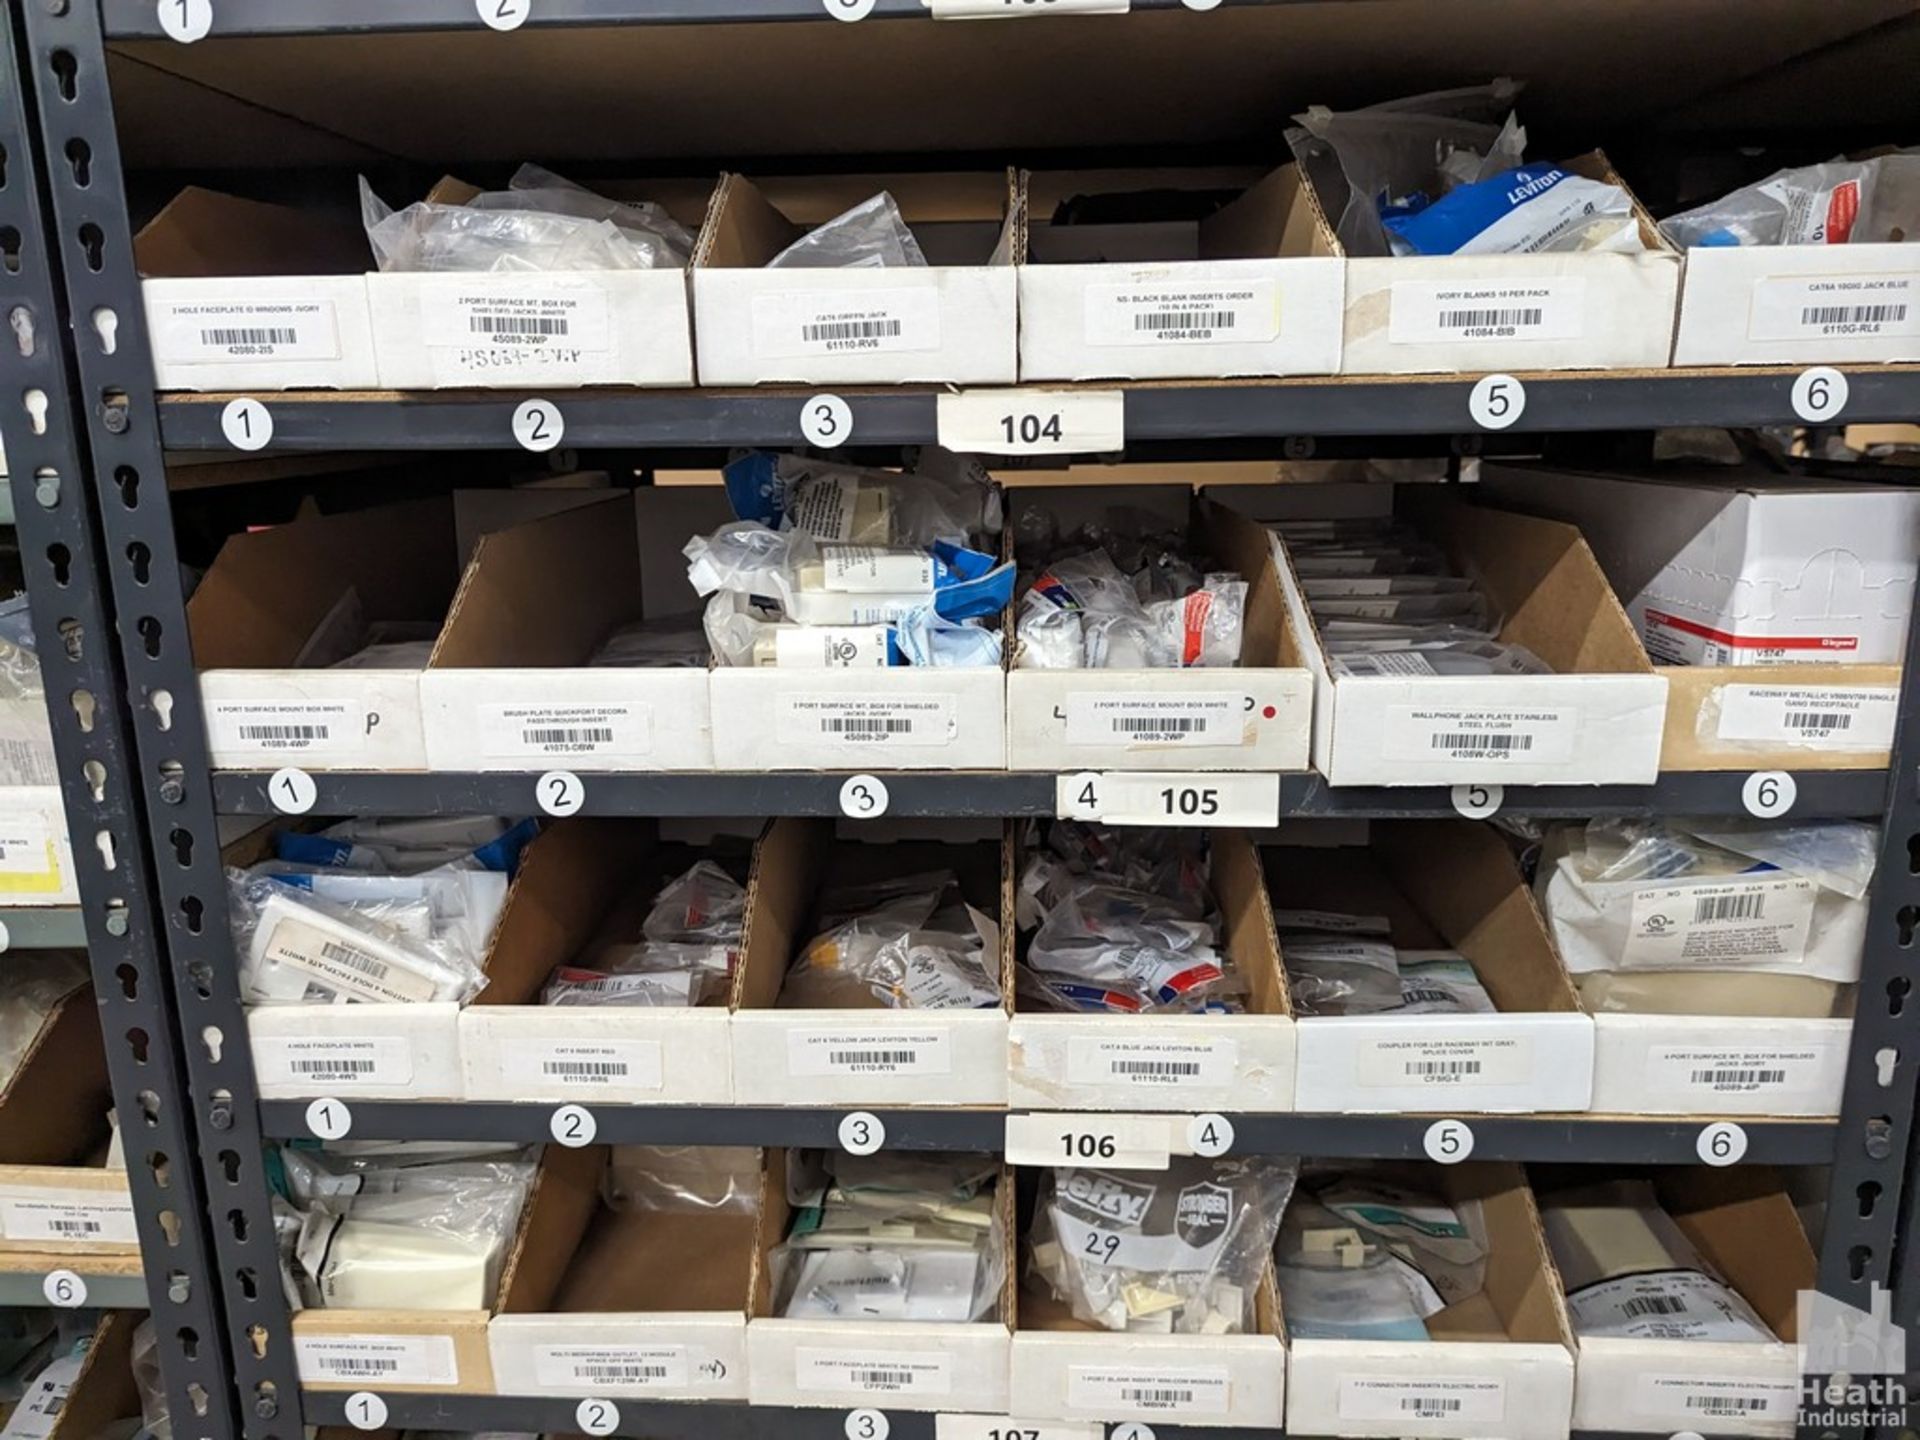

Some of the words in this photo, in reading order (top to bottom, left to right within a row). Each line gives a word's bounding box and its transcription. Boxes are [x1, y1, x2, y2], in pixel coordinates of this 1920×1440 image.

[1436, 292, 1462, 300] IVORY
[1463, 291, 1496, 299] BLANKS
[1509, 290, 1525, 298] PER
[1527, 289, 1551, 297] PACK
[1864, 282, 1885, 290] JACK
[1887, 281, 1909, 289] BLUE
[178, 305, 199, 314] HOLE
[201, 304, 245, 314] FACEPLATE
[256, 303, 293, 313] WINDOWS
[488, 298, 524, 307] SURFACE
[560, 300, 577, 308] FOR
[1132, 295, 1159, 303] BLACK
[1161, 294, 1188, 302] BLANK
[1190, 293, 1224, 301] INSERTS
[1226, 292, 1254, 300] ORDER
[867, 311, 888, 319] JACK
[492, 334, 548, 344] 45089-2WP
[826, 339, 879, 351] 61110-RV6
[1488, 384, 1509, 418] 5
[1807, 377, 1829, 410] 6
[237, 408, 251, 439] 1
[526, 409, 549, 440] 2
[815, 405, 836, 436] 3
[999, 414, 1063, 444] 104
[798, 702, 819, 710] PORT
[820, 702, 854, 710] SURFACE
[886, 703, 902, 711] FOR
[903, 703, 940, 711] SHIELDED
[1099, 702, 1120, 710] PORT
[1121, 702, 1156, 710] SURFACE
[1158, 702, 1185, 710] MOUNT
[1186, 702, 1203, 710] BOX
[1205, 702, 1228, 710] WHITE
[1749, 690, 1788, 698] RACEWAY
[1789, 691, 1828, 700] METALLIC
[1868, 694, 1896, 702] SINGLE
[1785, 700, 1808, 708] GANG
[1809, 701, 1860, 709] RECEPTACLE
[503, 710, 528, 718] BRUSH
[530, 709, 553, 717] PLATE
[554, 708, 596, 716] QUICKPORT
[597, 708, 628, 716] DECORA
[1411, 712, 1462, 720] WALLPHONE
[1463, 712, 1484, 720] JACK
[1486, 712, 1512, 721] PLATE
[1514, 713, 1559, 721] STAINLESS
[1458, 721, 1482, 729] STEEL
[1484, 721, 1512, 729] FLUSH
[1801, 728, 1830, 738] V5747
[1133, 732, 1185, 742] 41089-2WP
[281, 777, 298, 804] 1
[549, 780, 570, 808] 2
[851, 784, 875, 811] 3
[1078, 781, 1098, 810] 4
[1758, 778, 1779, 808] 6
[1160, 788, 1219, 816] 105
[1637, 891, 1655, 900] CAT
[1666, 890, 1681, 898] NO
[1773, 883, 1787, 891] NO
[858, 1036, 876, 1044] JACK
[908, 1035, 938, 1043] YELLOW
[1413, 1041, 1428, 1049] FOR
[1444, 1041, 1480, 1049] RACEWAY
[1422, 1048, 1447, 1056] SPLICE
[1449, 1048, 1475, 1056] COVER
[320, 1105, 334, 1131] 1
[565, 1112, 583, 1139] 2
[852, 1121, 870, 1146] 3
[1201, 1122, 1220, 1148] 4
[1441, 1127, 1459, 1154] 5
[1712, 1130, 1731, 1157] 6
[1061, 1134, 1115, 1157] 106
[1085, 1233, 1121, 1265] 29
[56, 1278, 73, 1300] 6
[1661, 1380, 1705, 1388] CONNECTOR
[1737, 1382, 1771, 1390] ELECTRIC
[359, 1400, 373, 1422] 1
[589, 1406, 606, 1428] 2
[857, 1415, 875, 1439] 3
